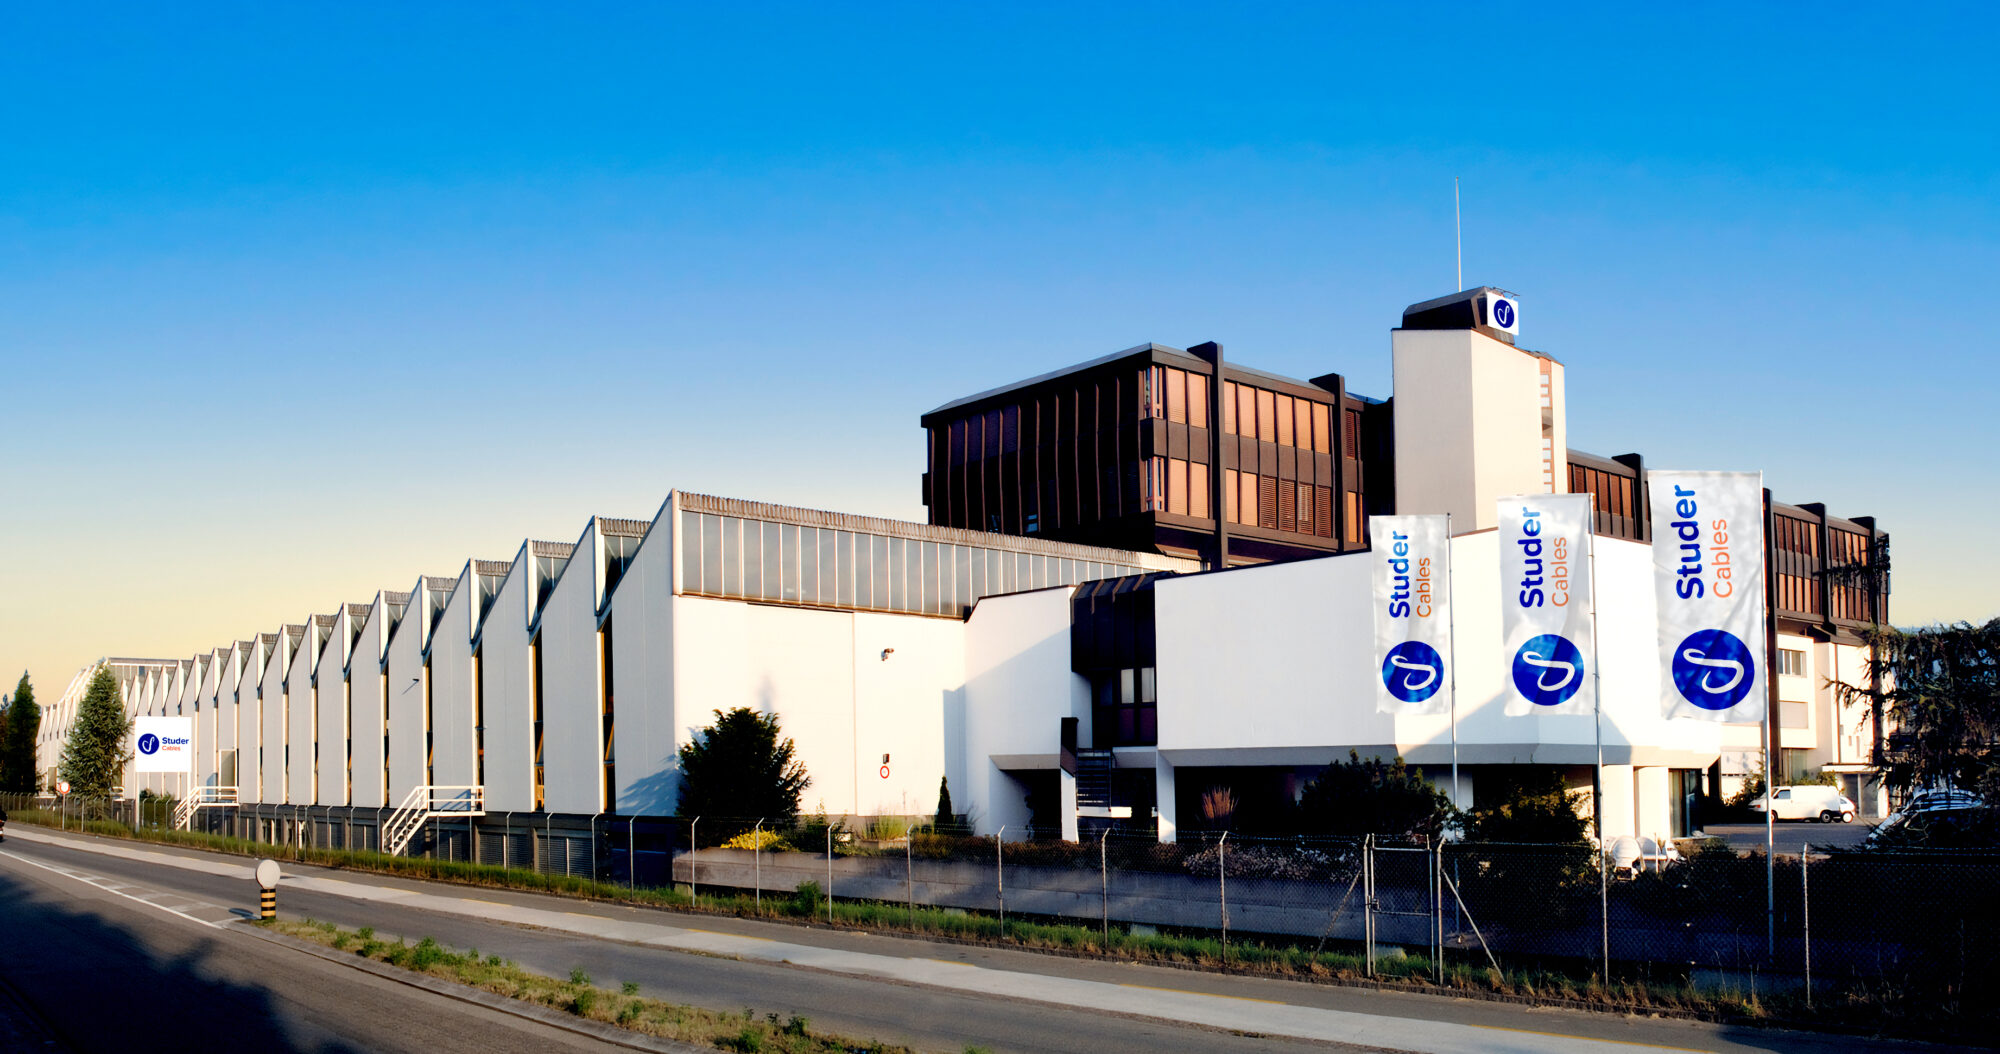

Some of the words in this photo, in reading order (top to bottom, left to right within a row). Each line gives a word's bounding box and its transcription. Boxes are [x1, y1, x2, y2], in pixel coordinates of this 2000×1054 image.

[1387, 530, 1411, 619] Studer
[1517, 506, 1545, 608] Studer
[1550, 536, 1570, 608] Cables
[1670, 484, 1705, 600] Studer
[1709, 518, 1733, 599] Cables
[1415, 557, 1433, 619] Cables
[161, 737, 189, 745] Studer
